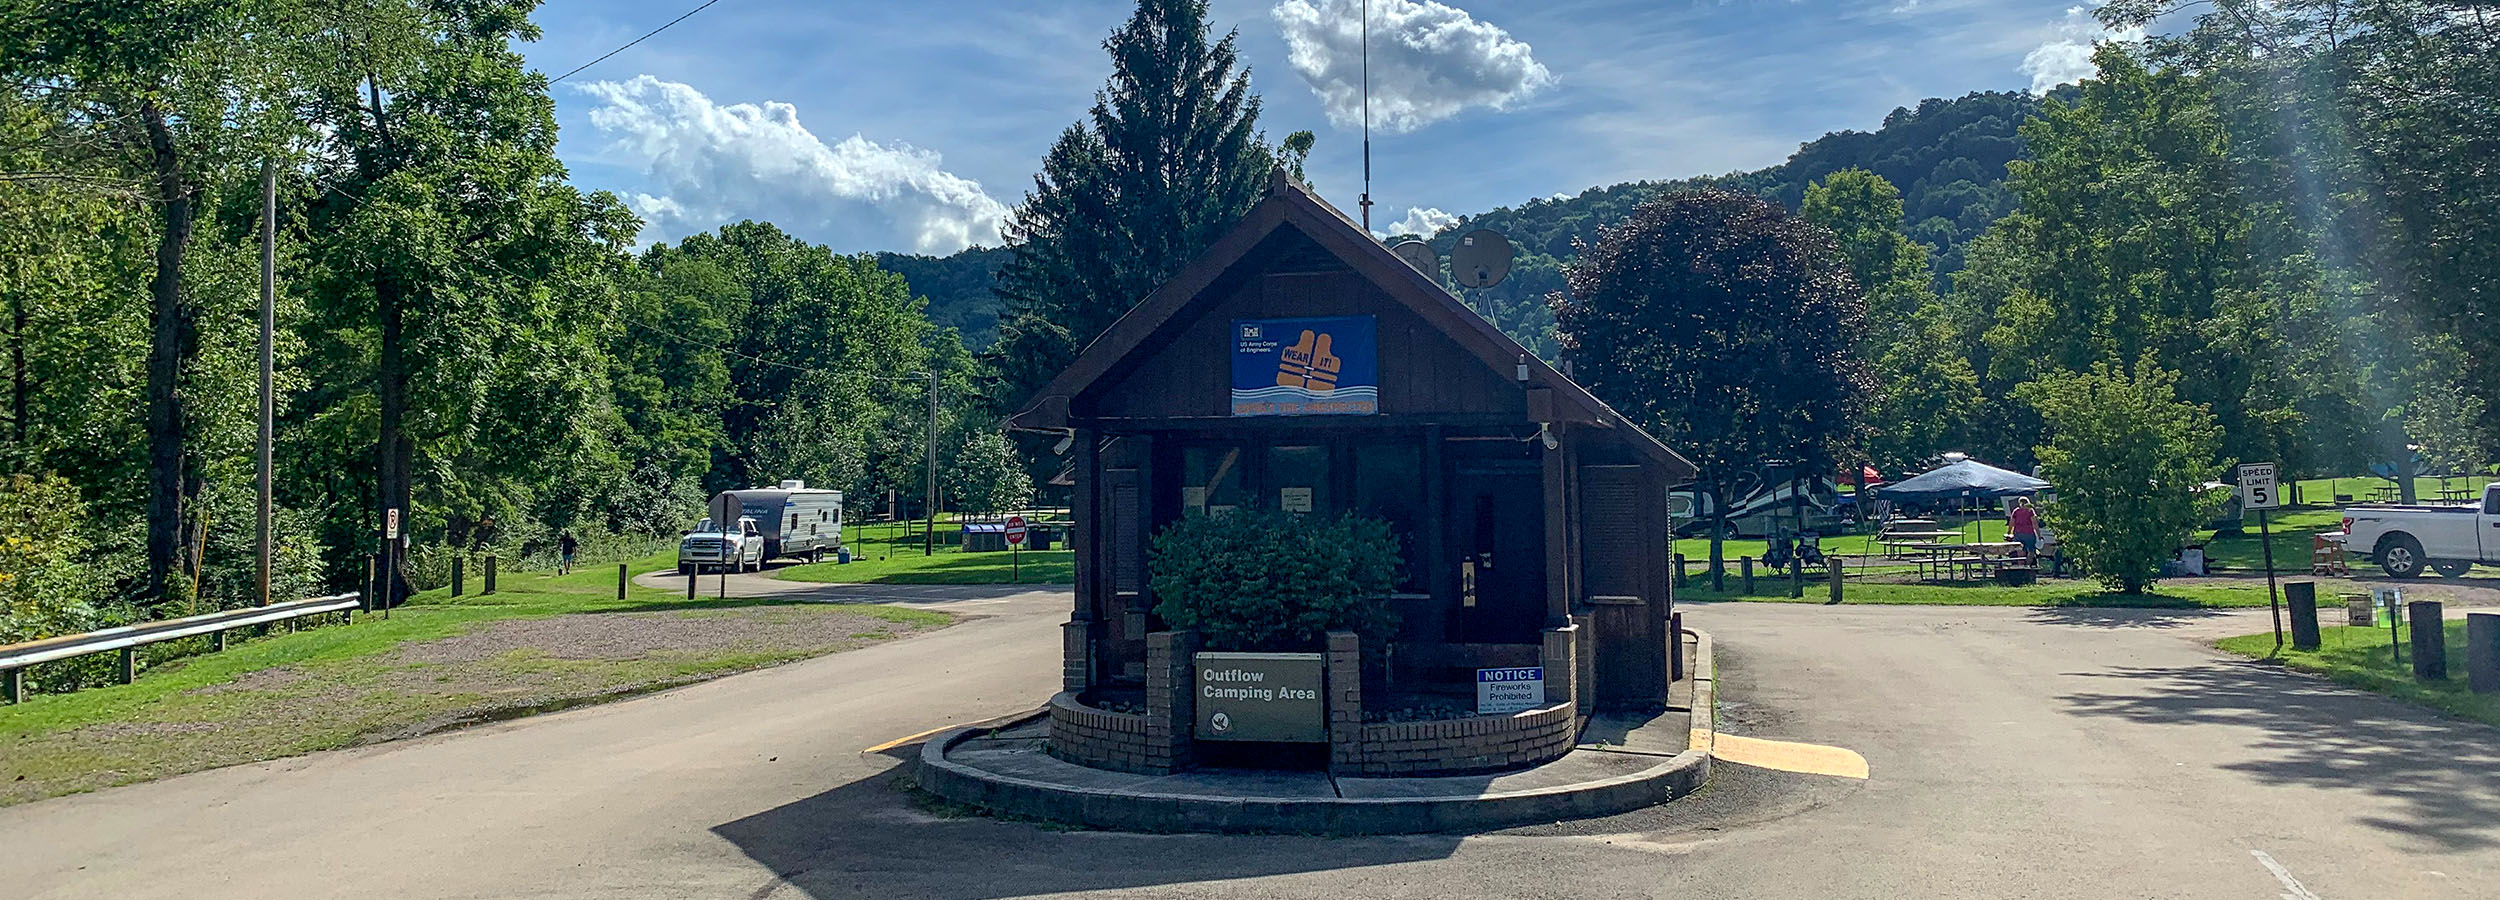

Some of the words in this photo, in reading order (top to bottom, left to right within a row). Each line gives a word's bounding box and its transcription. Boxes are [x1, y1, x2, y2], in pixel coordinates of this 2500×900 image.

[1284, 348, 1309, 364] WEAR
[1319, 356, 1332, 368] IT!
[2242, 468, 2272, 477] SPEED
[2246, 478, 2270, 486] LIMIT
[2253, 487, 2268, 504] 5
[1203, 668, 1264, 682] Outflow
[1485, 669, 1536, 681] NOTICE
[1490, 682, 1531, 691] Fireworks
[1203, 685, 1273, 701] Camping
[1278, 686, 1316, 700] Area
[1489, 692, 1532, 700] Prohibited
